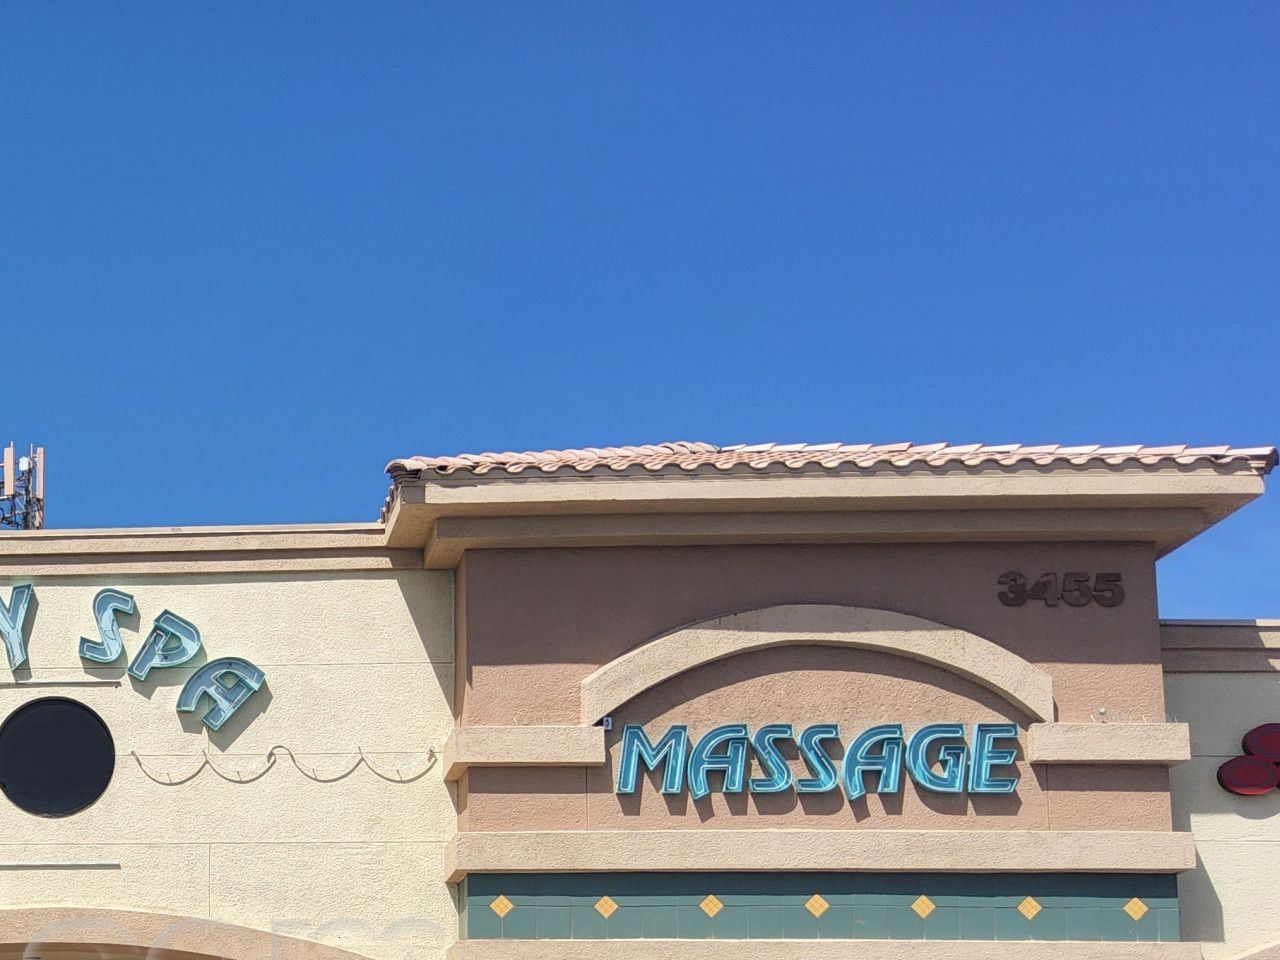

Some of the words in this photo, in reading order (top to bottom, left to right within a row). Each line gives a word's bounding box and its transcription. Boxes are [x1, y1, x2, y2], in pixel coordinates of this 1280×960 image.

[997, 571, 1126, 607] 3455
[78, 588, 266, 731] SPA
[616, 723, 1020, 801] MASSAGE
